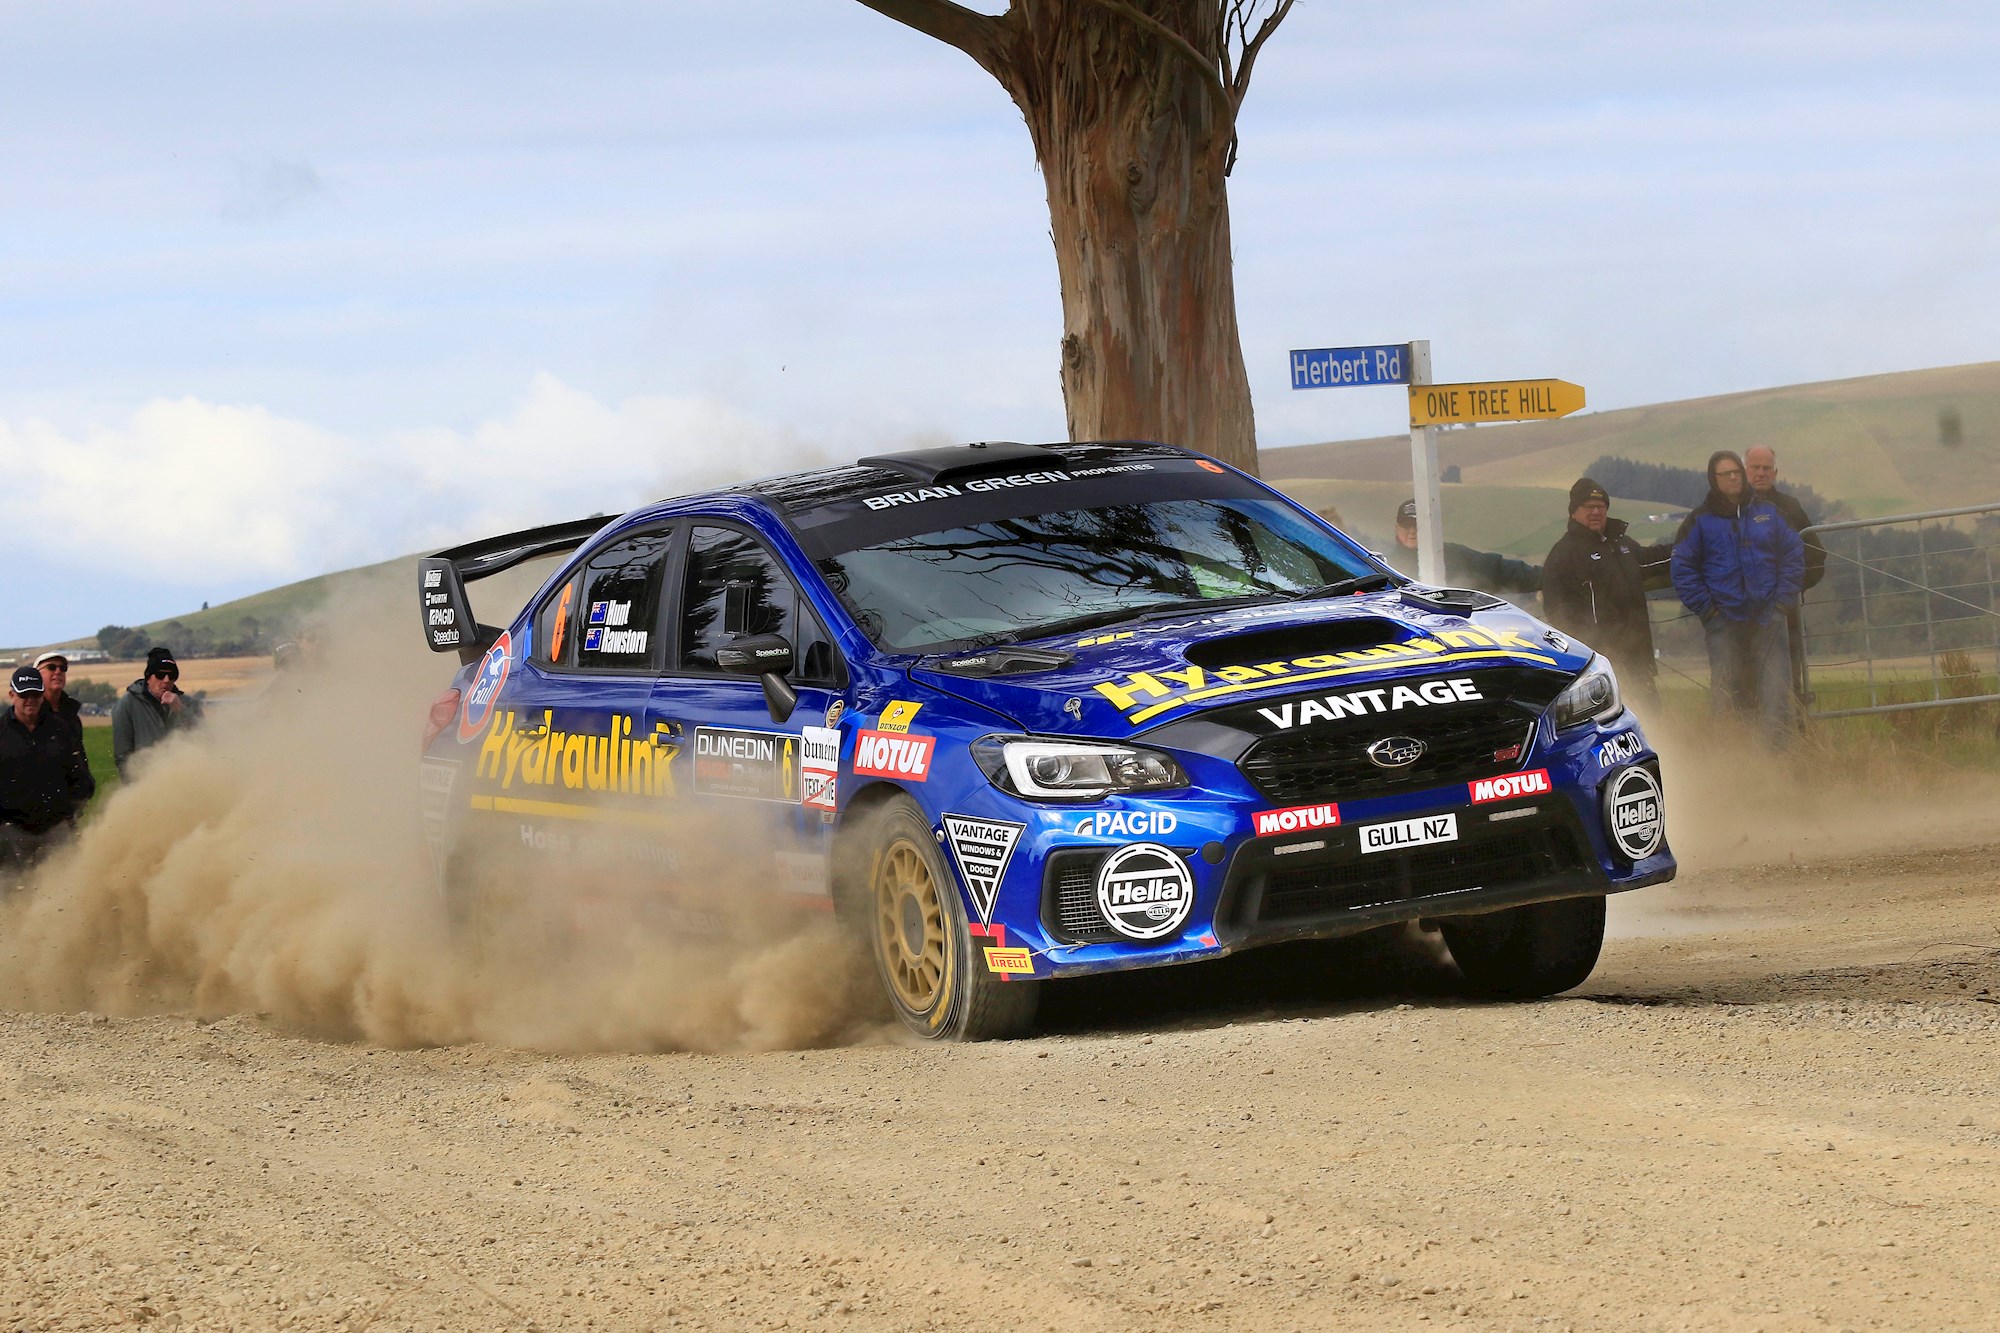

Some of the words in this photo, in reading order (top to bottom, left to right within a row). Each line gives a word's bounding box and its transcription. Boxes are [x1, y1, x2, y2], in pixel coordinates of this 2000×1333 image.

[1293, 352, 1369, 385] Herbert
[1376, 350, 1400, 380] Rd
[1427, 391, 1460, 418] ONE
[1468, 389, 1510, 416] TREE
[1519, 387, 1557, 413] HILL
[1195, 459, 1225, 474] 6
[862, 485, 963, 511] BRIAN
[965, 469, 1071, 492] GREEN
[1070, 463, 1155, 478] PROPERTIES
[436, 608, 455, 625] PAGID
[551, 582, 572, 662] 6
[605, 599, 631, 626] Hunt
[433, 629, 459, 644] Speedhub
[600, 627, 648, 653] Rawstorn
[755, 647, 790, 658] Speedhub
[951, 656, 987, 668] Speedhub
[470, 678, 498, 705] Gull
[1256, 677, 1484, 730] VANTAGE
[879, 722, 908, 732] DUNLOP
[476, 709, 677, 798] Hydraulink
[697, 734, 774, 762] DUNEDIN
[856, 735, 928, 775] MOTUL
[782, 738, 793, 799] 6
[1474, 772, 1549, 801] MOTUL
[1095, 811, 1177, 835] PAGID
[1258, 805, 1337, 834] MOTUL
[1618, 800, 1656, 828] Hella
[953, 822, 1009, 842] VANTAGE
[1367, 824, 1420, 847] GULL
[1424, 818, 1450, 840] NZ
[960, 843, 996, 857] WINDOWS
[995, 847, 1002, 858] &
[969, 866, 994, 876] DOORS
[1112, 878, 1179, 905] Hella
[989, 952, 1028, 968] PIRELLI
